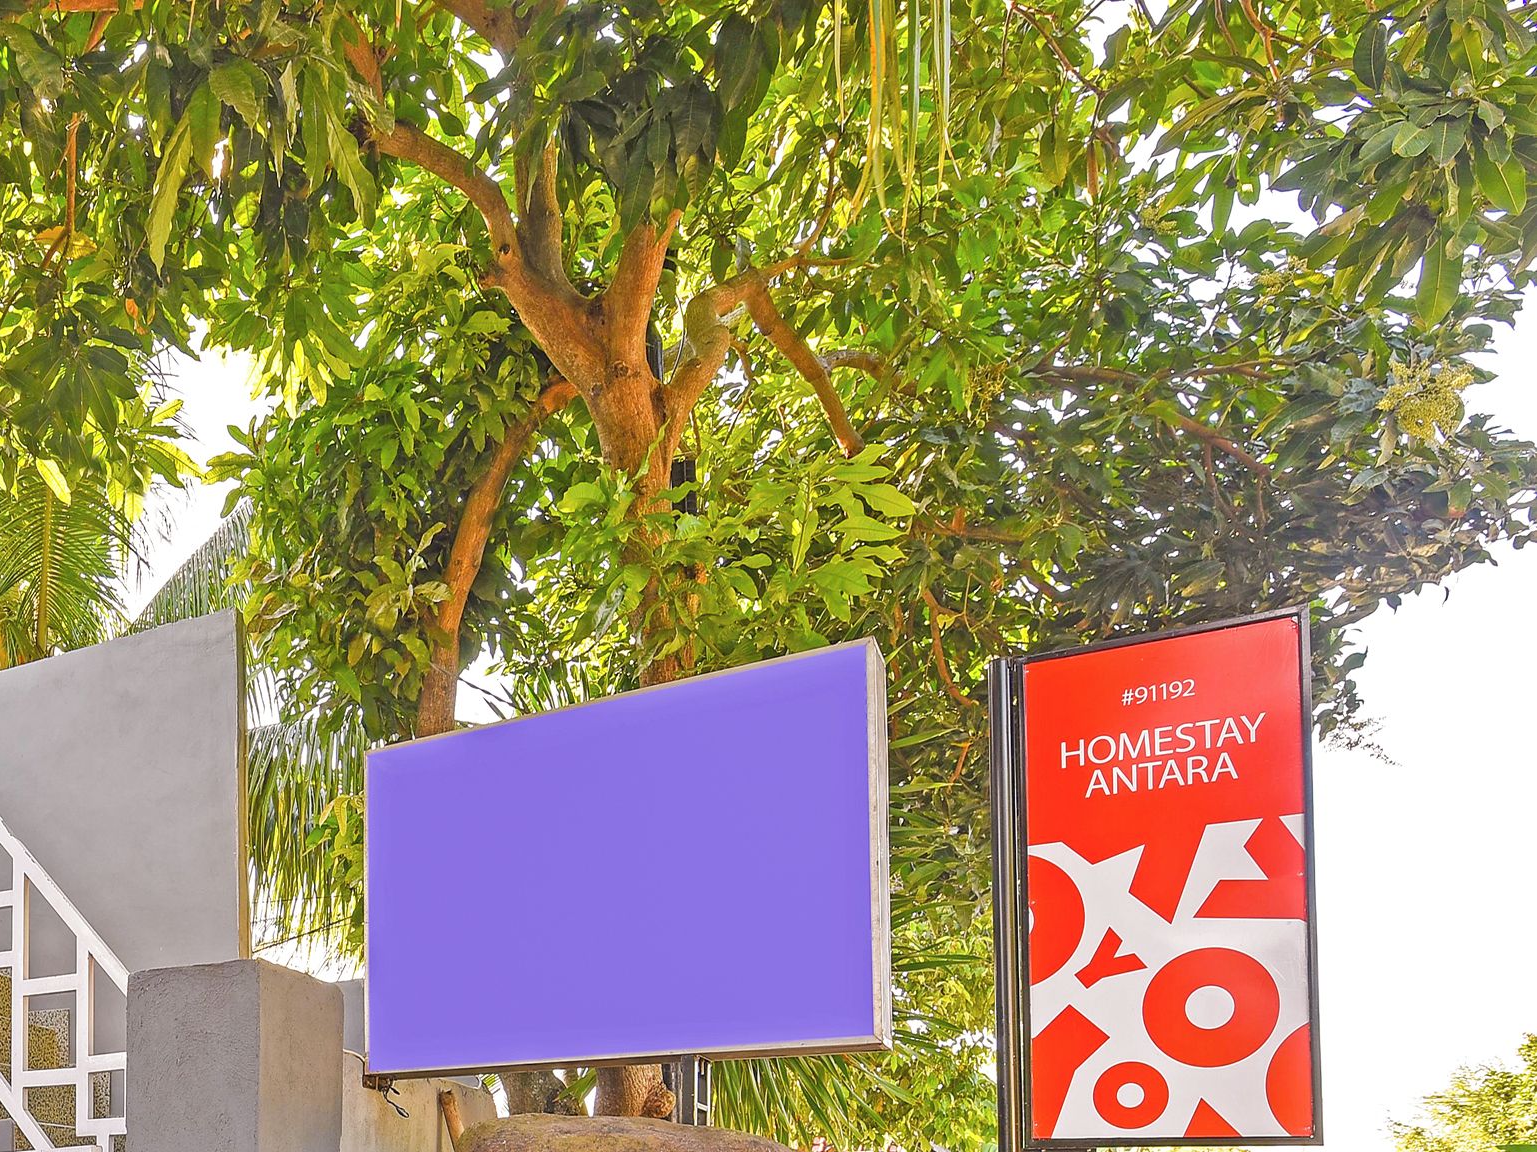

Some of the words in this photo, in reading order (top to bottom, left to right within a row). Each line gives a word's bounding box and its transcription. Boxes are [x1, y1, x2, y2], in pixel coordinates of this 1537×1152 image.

[1121, 679, 1196, 706] #91192
[1060, 712, 1267, 769] HOMESTAY
[1085, 752, 1239, 799] ANTARA
